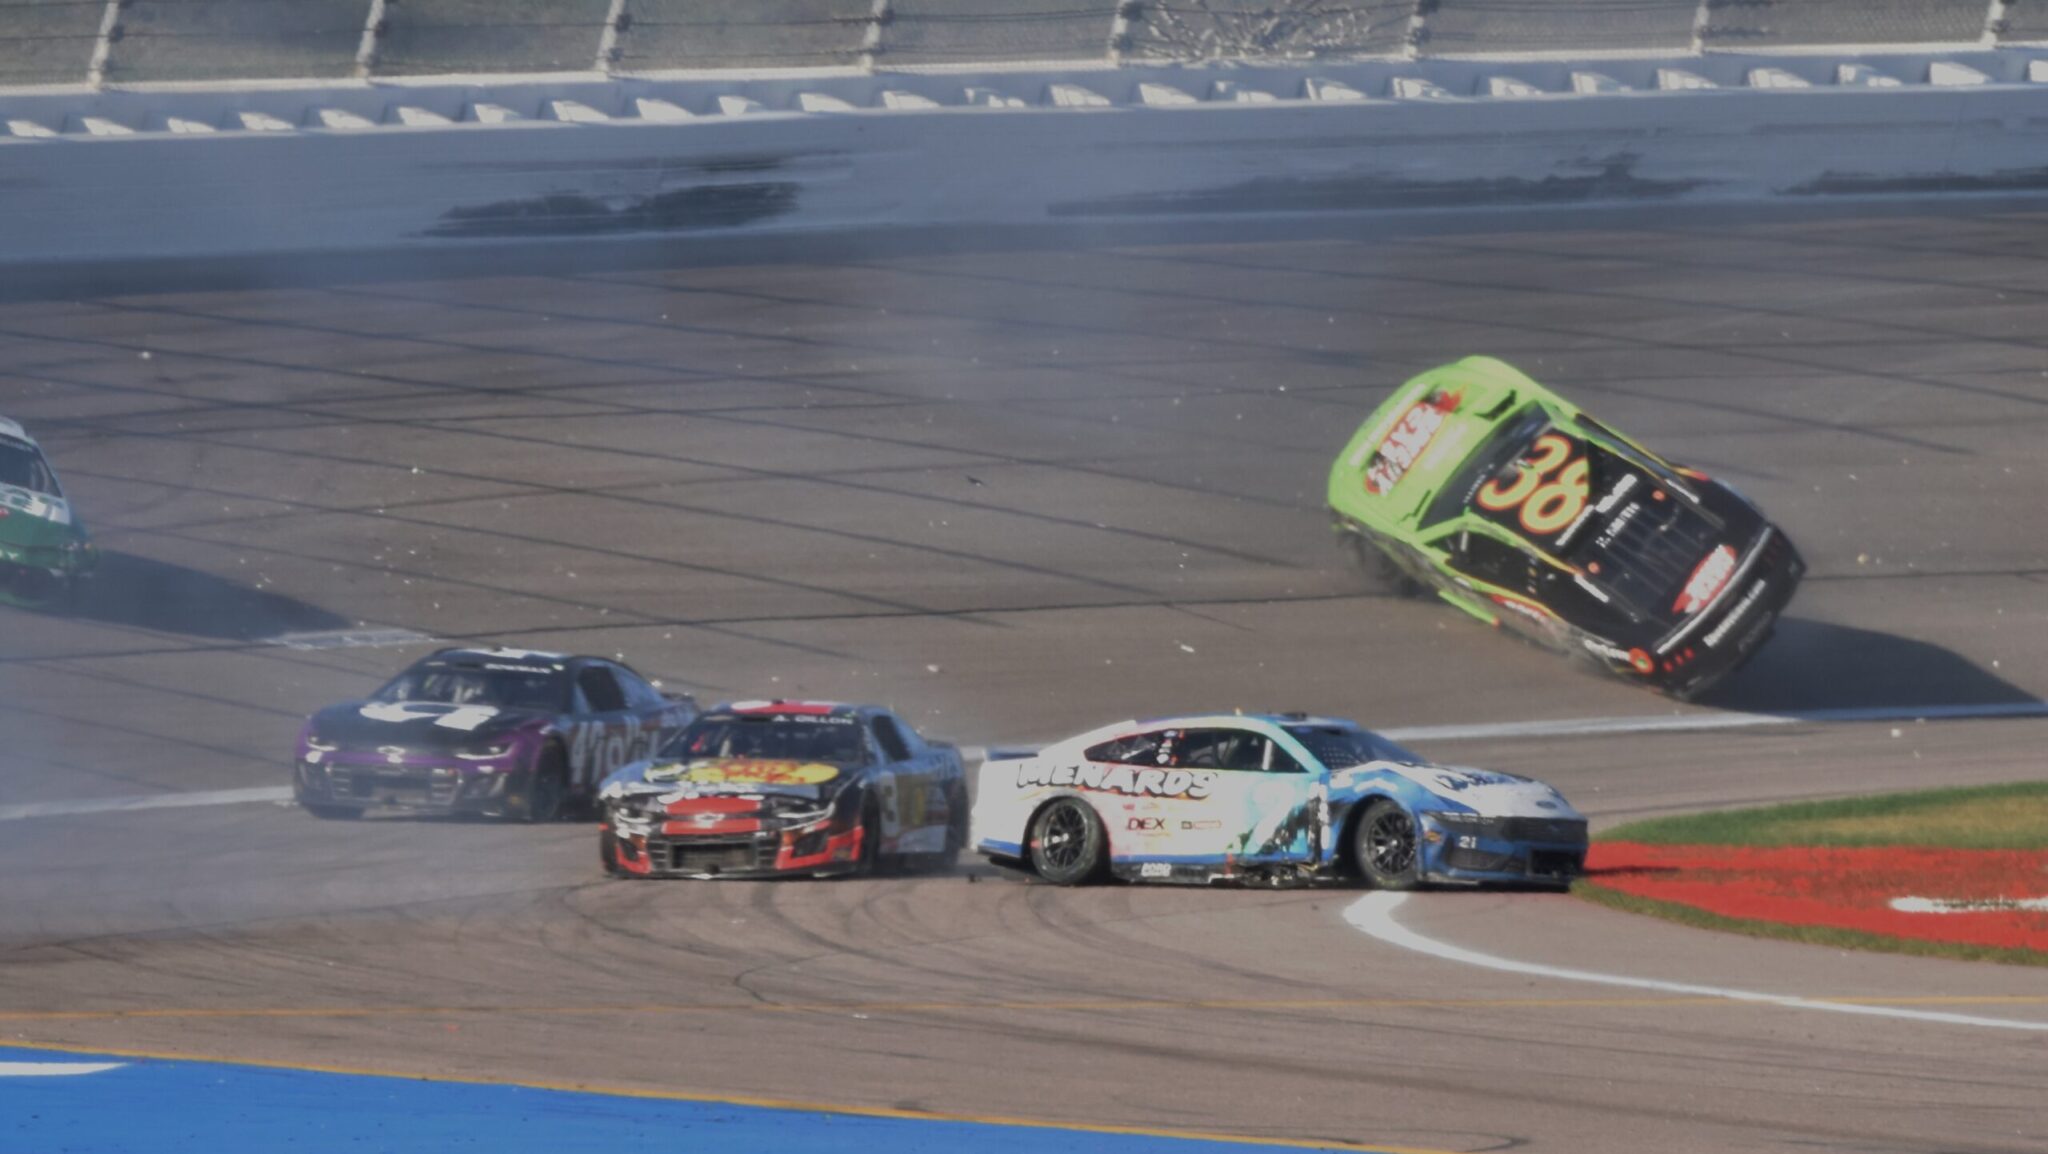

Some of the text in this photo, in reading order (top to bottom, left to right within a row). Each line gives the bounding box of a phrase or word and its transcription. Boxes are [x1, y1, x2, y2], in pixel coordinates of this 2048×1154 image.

[1477, 435, 1590, 535] 38
[1017, 763, 1218, 801] MENARDS
[1126, 816, 1166, 831] DEX
[1458, 835, 1477, 850] 21
